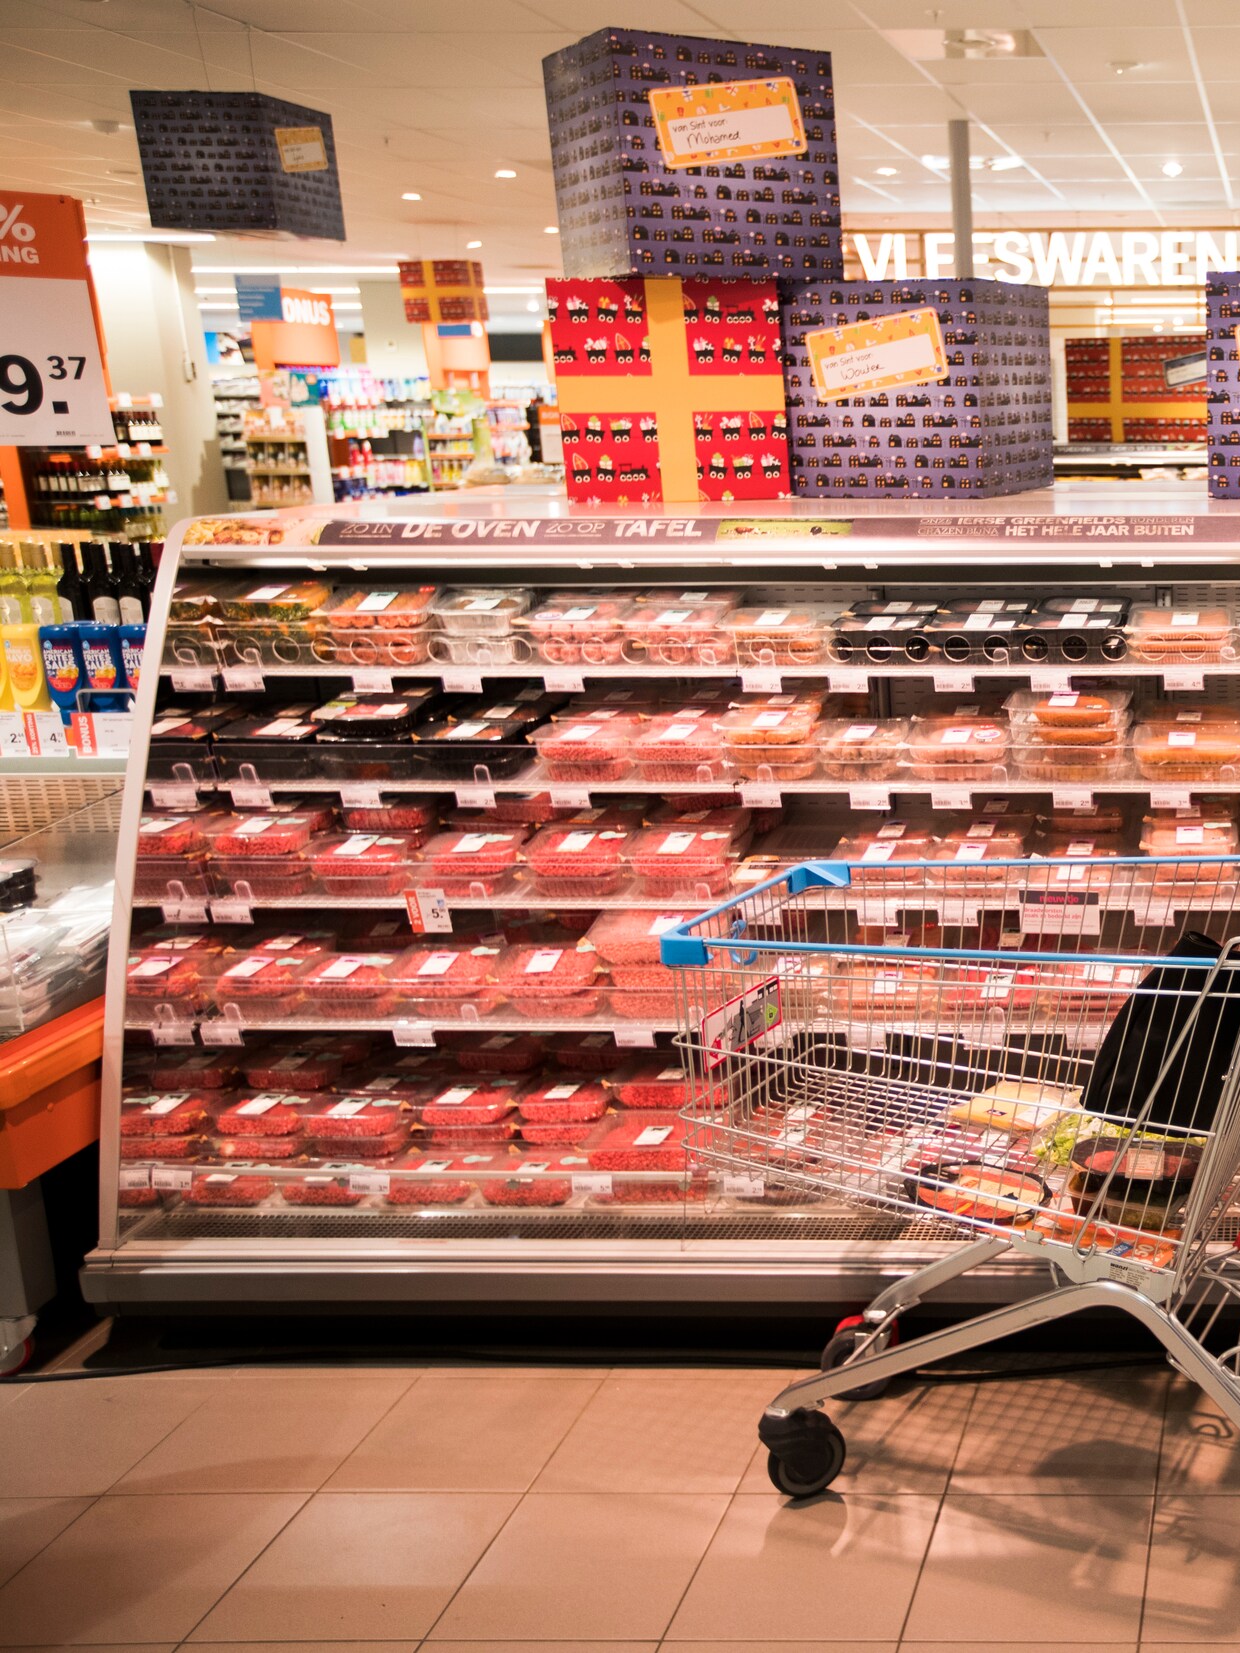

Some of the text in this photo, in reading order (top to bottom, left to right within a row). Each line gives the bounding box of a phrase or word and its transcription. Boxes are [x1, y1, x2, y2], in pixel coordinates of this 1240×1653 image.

[671, 118, 727, 133] van Sint voor
[687, 130, 741, 149] Mohamed
[0, 245, 40, 265] NG
[281, 297, 331, 327] ONUS
[824, 352, 872, 370] van Sint voor
[341, 519, 702, 538] ZO IN DE OVEN ZO OP TAFEL
[957, 517, 1006, 525] IERSE
[1010, 516, 1127, 525] GREENFIELDS
[1005, 525, 1039, 536] HET
[1041, 525, 1083, 536] HELE
[1085, 525, 1131, 537] JAAR
[1133, 525, 1195, 536] BUITEN
[44, 653, 75, 661] FRITES
[78, 715, 93, 754] BONUS
[1039, 894, 1080, 905] neuwtje
